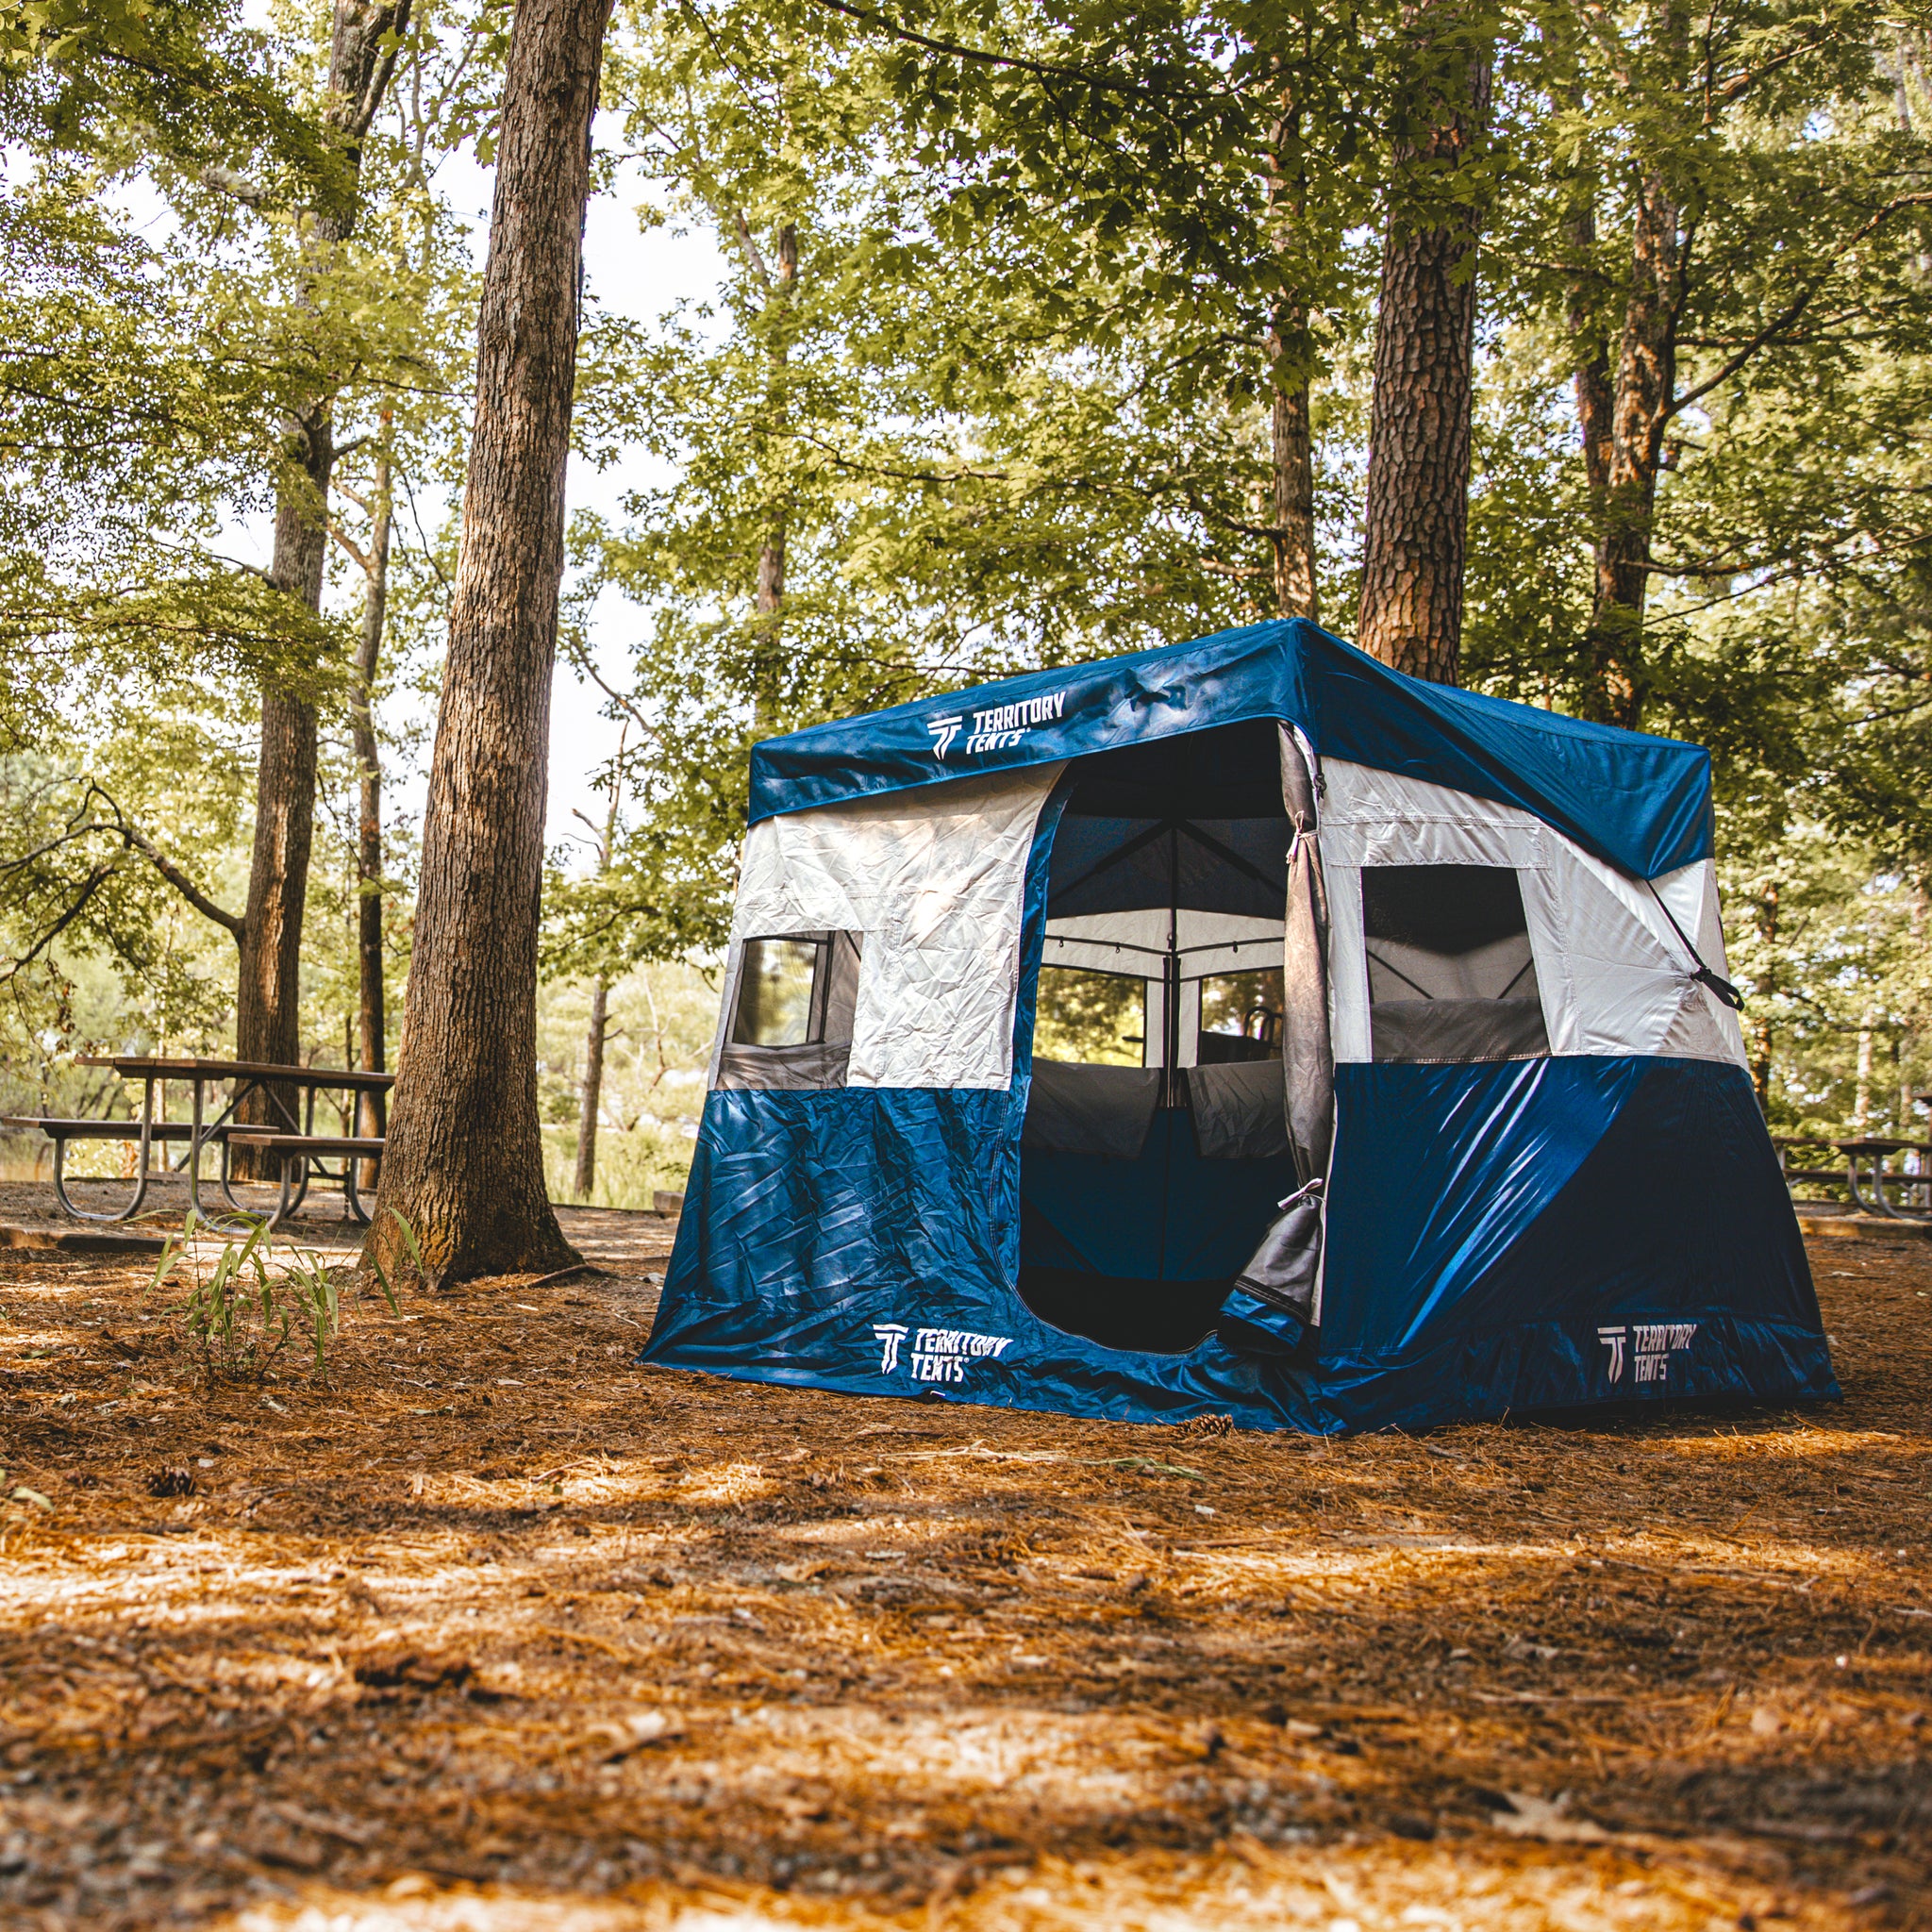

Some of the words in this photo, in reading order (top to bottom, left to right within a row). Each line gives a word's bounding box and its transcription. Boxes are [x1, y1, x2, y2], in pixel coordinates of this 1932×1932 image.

[973, 691, 1066, 735] TERRITORY
[966, 727, 1025, 755] TENTS
[915, 1327, 1014, 1357] TERRITORY
[910, 1352, 964, 1383] TENTS
[1634, 1353, 1670, 1383] TENTS
